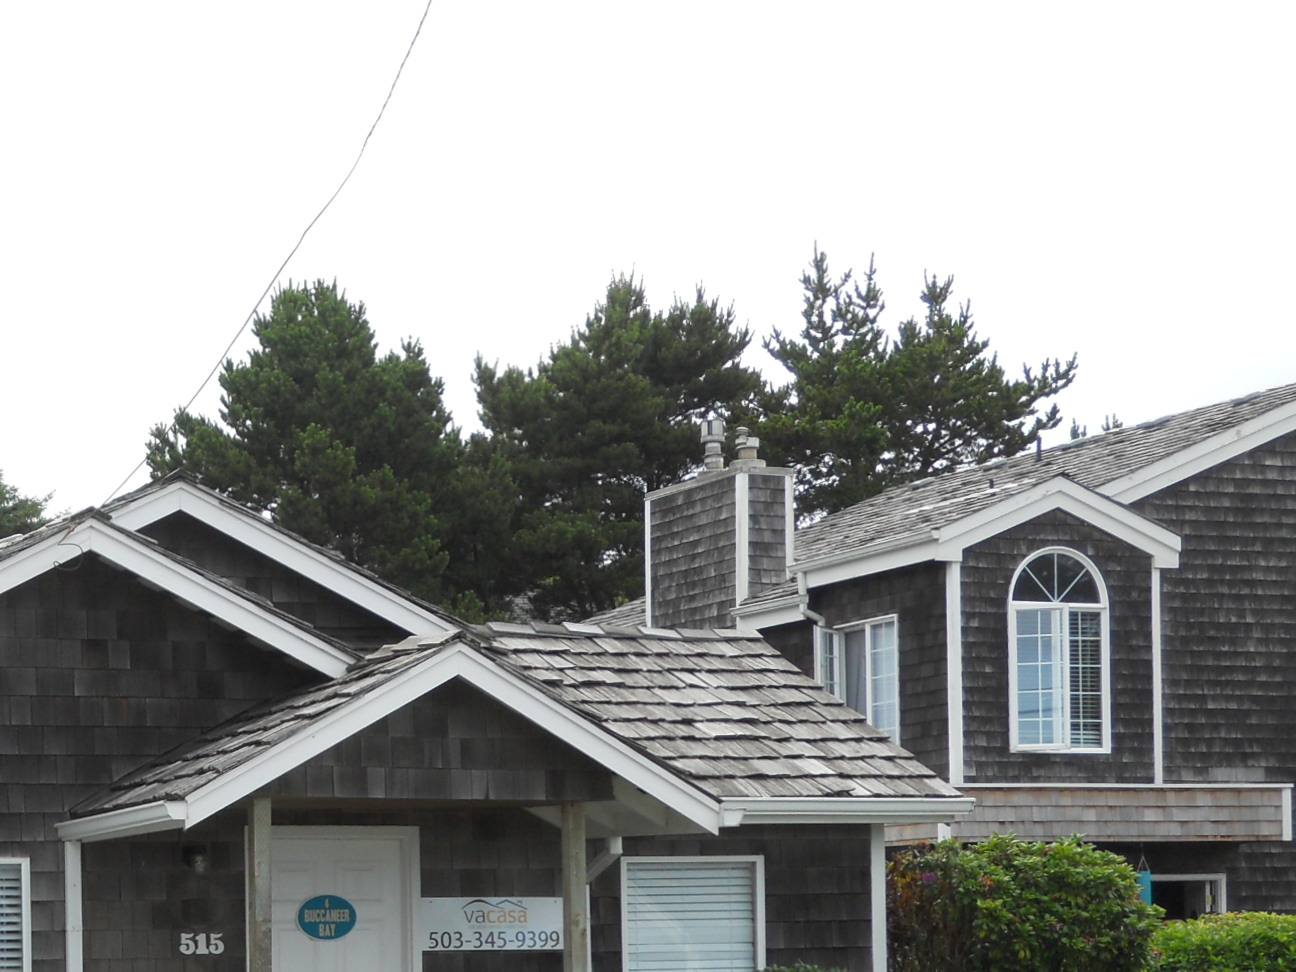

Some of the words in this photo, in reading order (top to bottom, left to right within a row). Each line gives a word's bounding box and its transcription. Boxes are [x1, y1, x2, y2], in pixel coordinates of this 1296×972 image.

[304, 909, 350, 922] BUCCANEER
[464, 909, 528, 924] vacasa
[318, 924, 336, 937] BAY
[179, 933, 225, 955] 515
[428, 931, 560, 949] 503-345-9399
